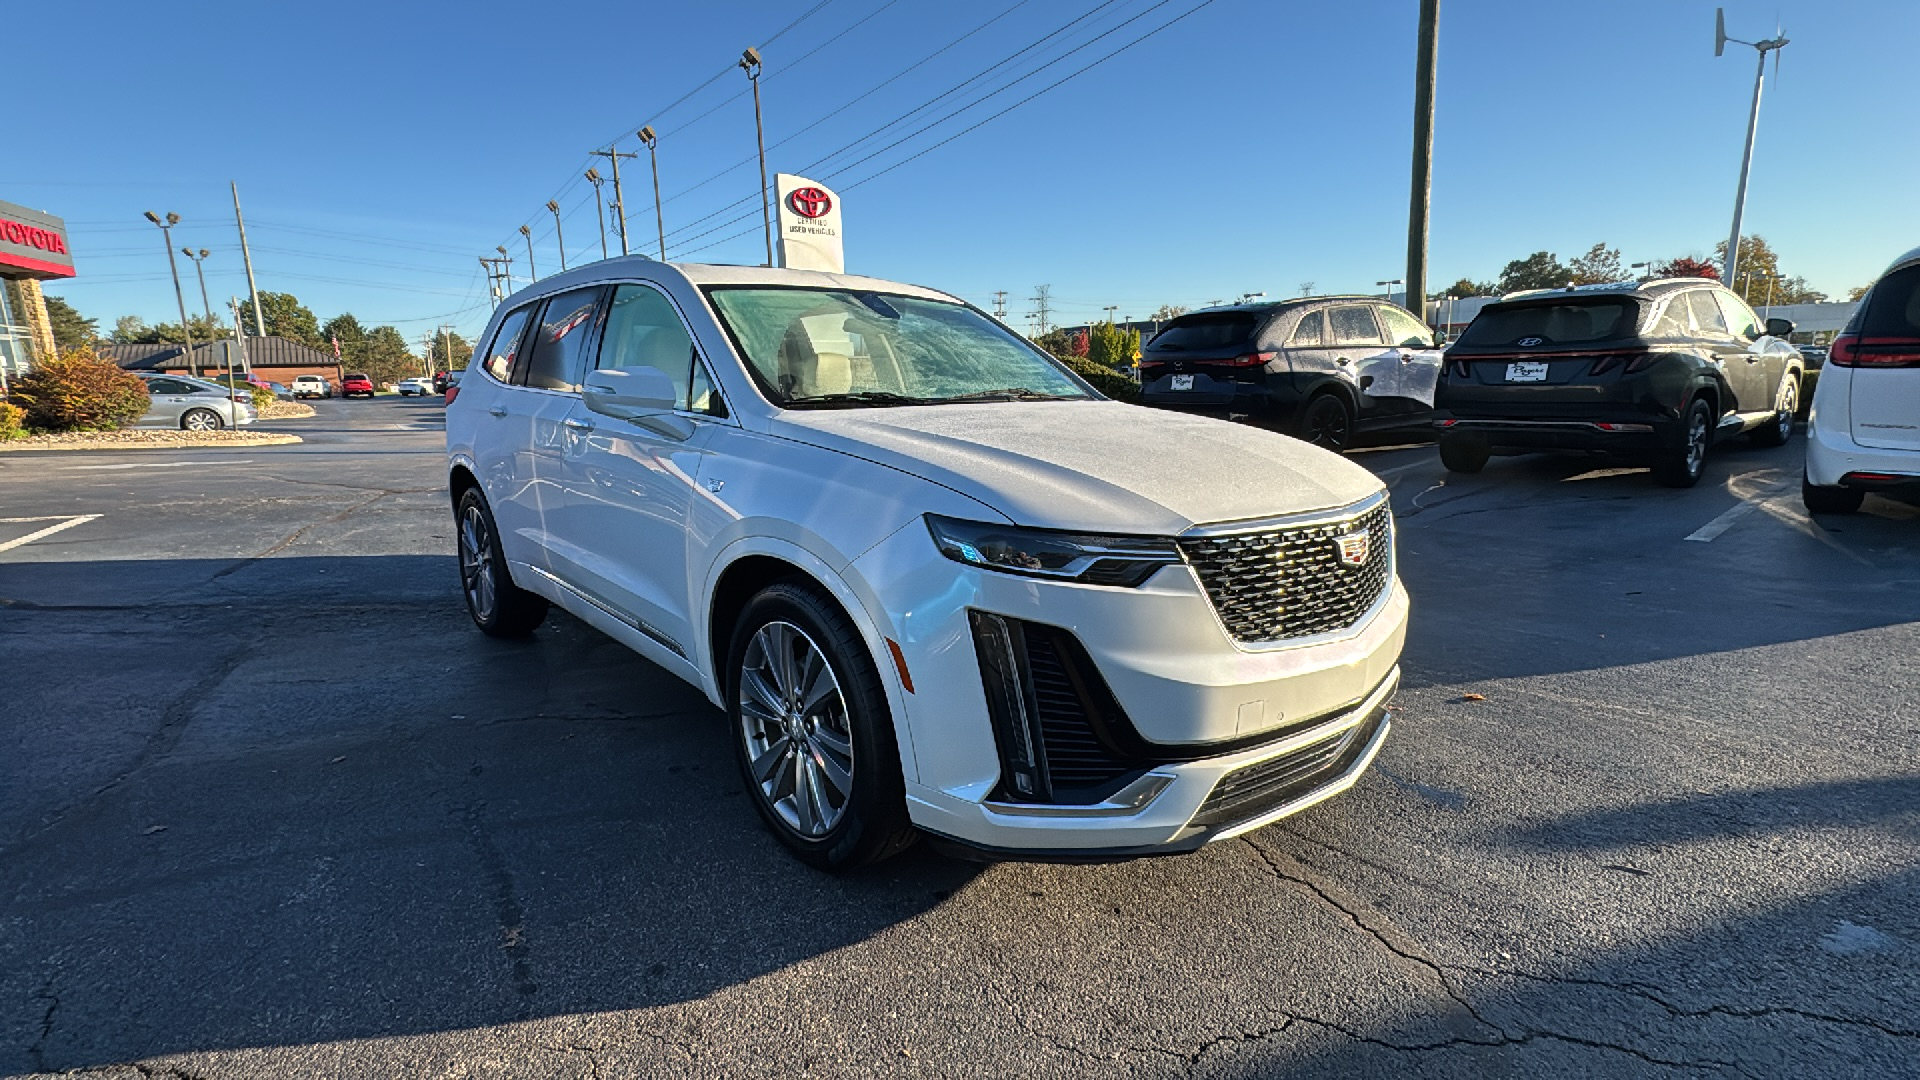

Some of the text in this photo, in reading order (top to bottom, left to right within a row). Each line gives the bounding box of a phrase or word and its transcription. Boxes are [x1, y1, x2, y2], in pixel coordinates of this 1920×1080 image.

[797, 217, 828, 227] CERTIFIED
[789, 225, 836, 236] USED VEHICLES
[0, 219, 67, 255] TOYOTA
